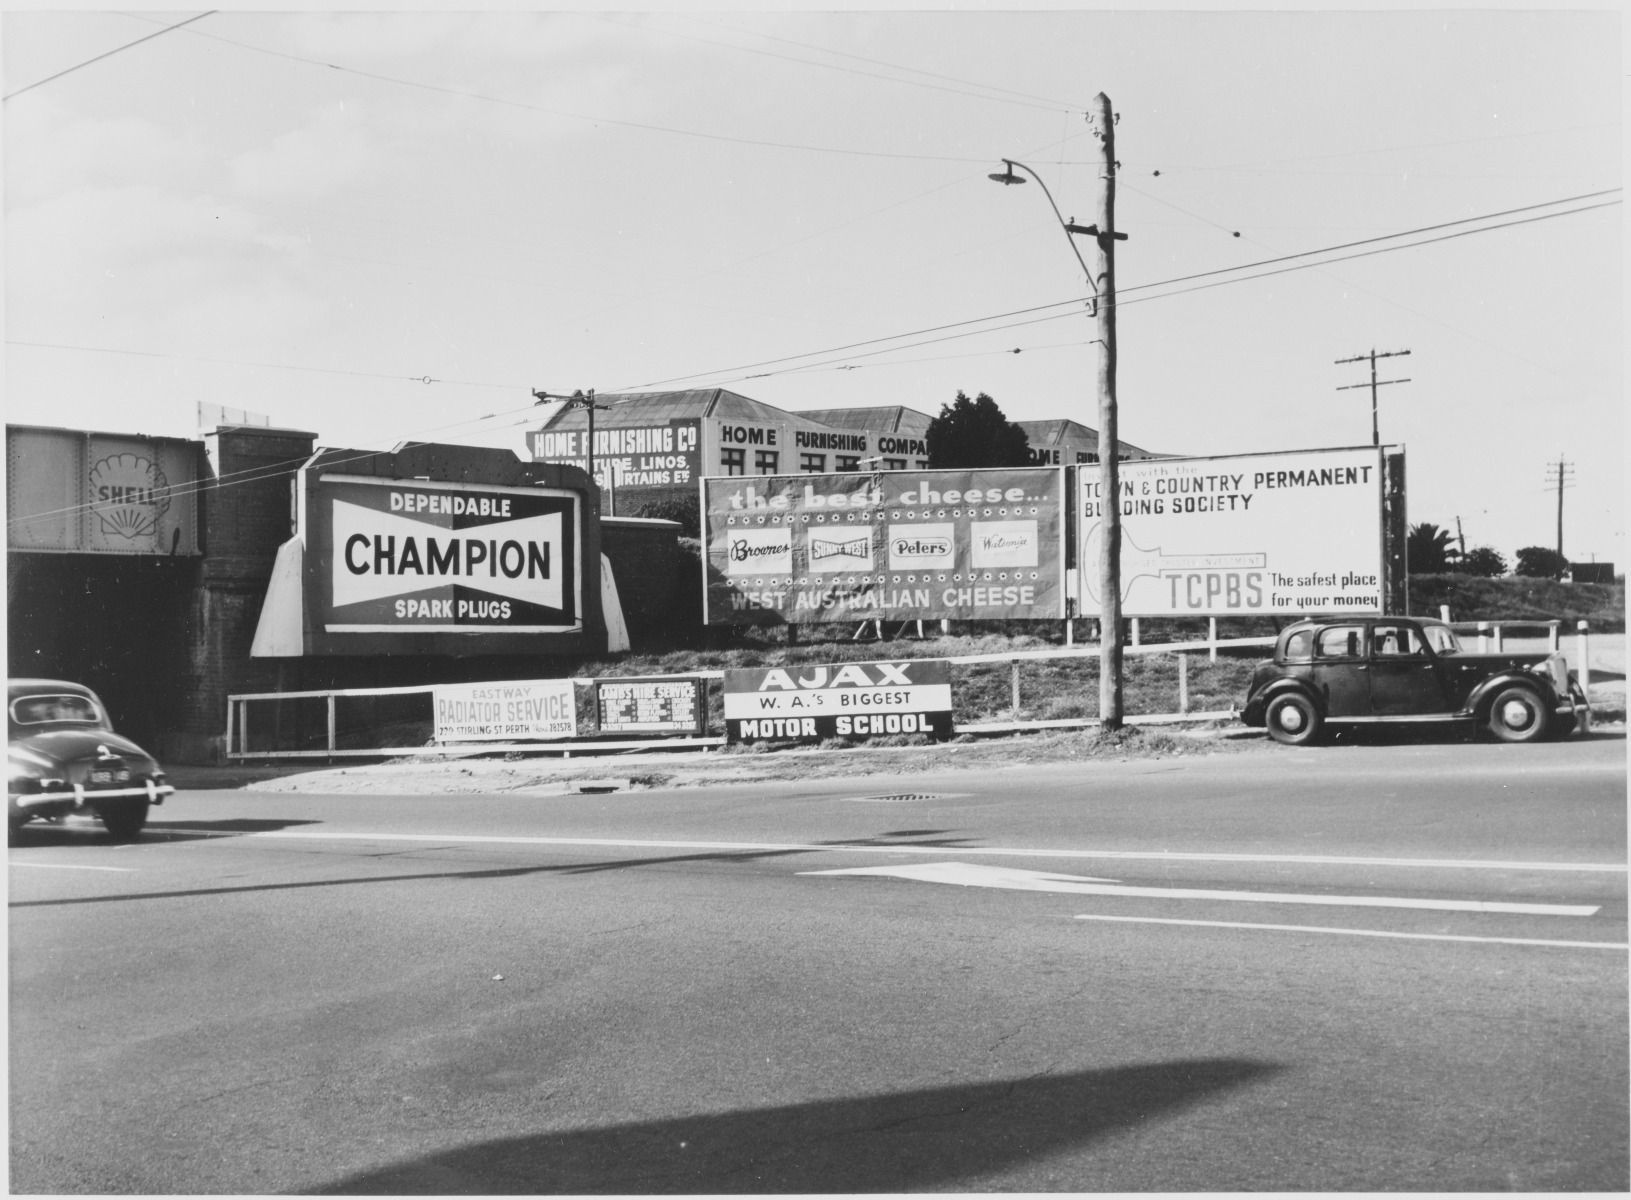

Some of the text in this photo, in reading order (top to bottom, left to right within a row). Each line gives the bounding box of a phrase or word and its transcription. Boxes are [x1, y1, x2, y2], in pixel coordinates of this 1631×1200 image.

[534, 432, 577, 458] HOME
[722, 425, 932, 456] HOME FURNISHING COMPA
[641, 455, 690, 471] LINOS,
[1027, 449, 1060, 465] OME
[1137, 467, 1169, 477] with
[1176, 464, 1199, 475] the
[1084, 466, 1373, 498] TON & COUNTRY PERMANENT
[98, 485, 157, 505] SHELL
[390, 492, 511, 517] DEPENDABLE
[728, 487, 788, 509] the
[804, 485, 884, 508] best
[1172, 494, 1254, 514] SOCIETY
[731, 538, 790, 562] Brownes
[898, 539, 946, 555] Peters
[979, 535, 1029, 551] Watsonia
[345, 533, 551, 580] CHAMPION
[1297, 572, 1337, 588] safest
[1341, 571, 1377, 589] place
[731, 587, 1035, 610] WEST AUSTRALIAN CHEESE
[1166, 572, 1263, 609] TCPBS
[395, 599, 512, 619] SPARK PLUGS
[1271, 594, 1292, 608] for
[1296, 595, 1329, 609] your
[759, 663, 913, 691] AJAX
[472, 687, 532, 699] EASTWAY
[657, 685, 695, 698] SERVICE
[841, 692, 911, 706] BIGGEST
[439, 693, 570, 724] RADIATOR SERVICE
[457, 724, 492, 736] STIRLING
[494, 723, 503, 735] ST
[505, 724, 530, 736] PERTH
[740, 714, 934, 738] MOTOR SCHOOL
